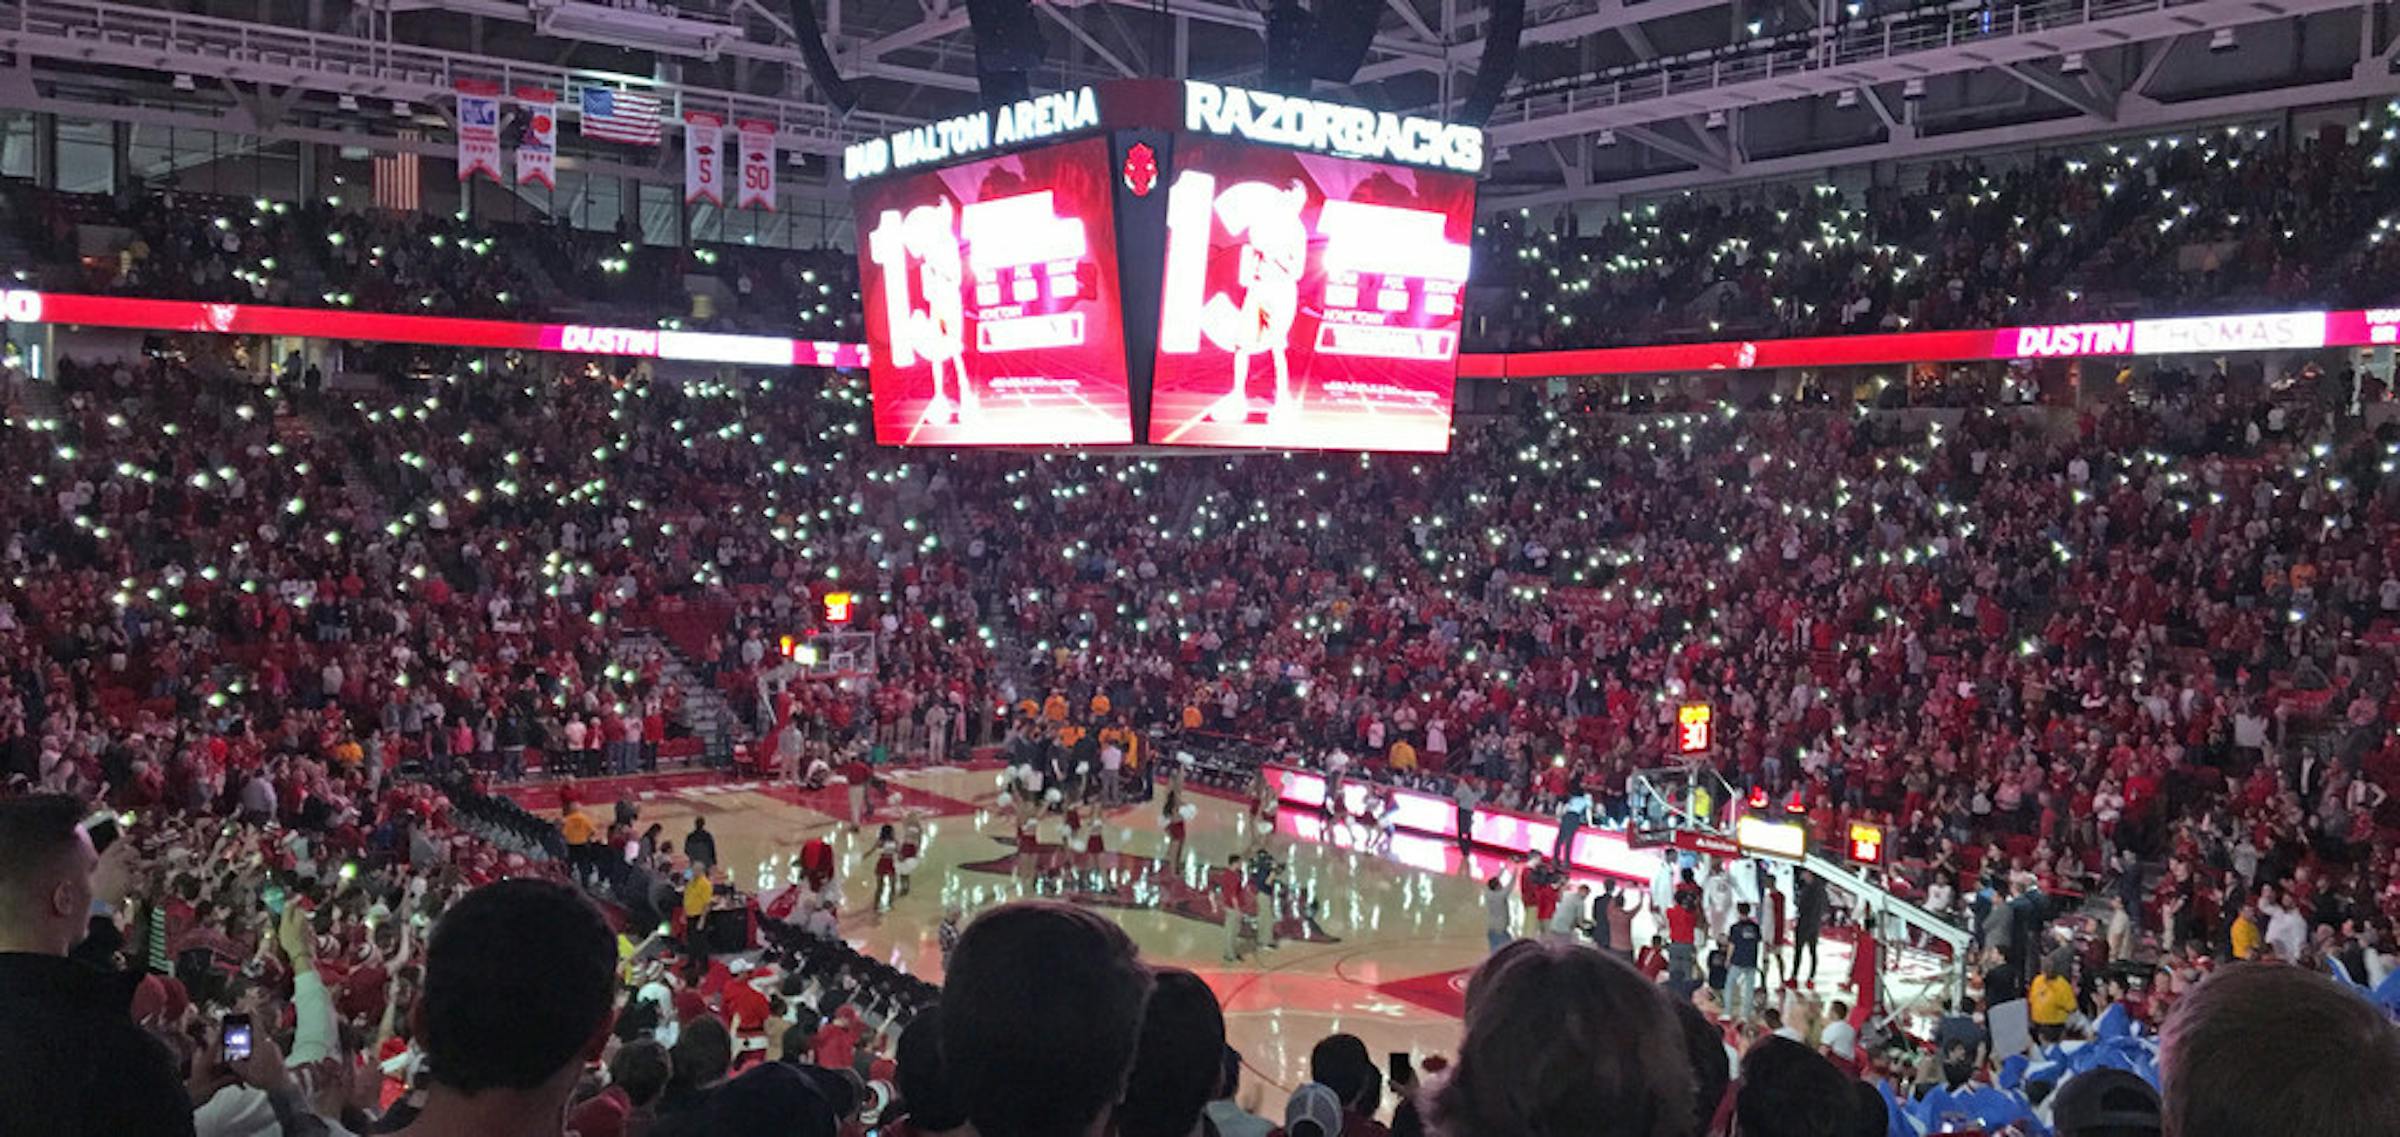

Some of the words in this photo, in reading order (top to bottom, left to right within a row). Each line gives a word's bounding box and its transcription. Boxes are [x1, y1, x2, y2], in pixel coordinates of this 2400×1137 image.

[891, 111, 990, 169] WALTON
[995, 86, 1099, 146] ARENA
[1184, 79, 1483, 173] RAZORBACKS
[744, 163, 771, 191] 50
[561, 325, 657, 356] DUSTIN
[2017, 323, 2132, 356] DUSTIN
[2149, 317, 2295, 350] THOMAS
[1680, 721, 1708, 751] 30
